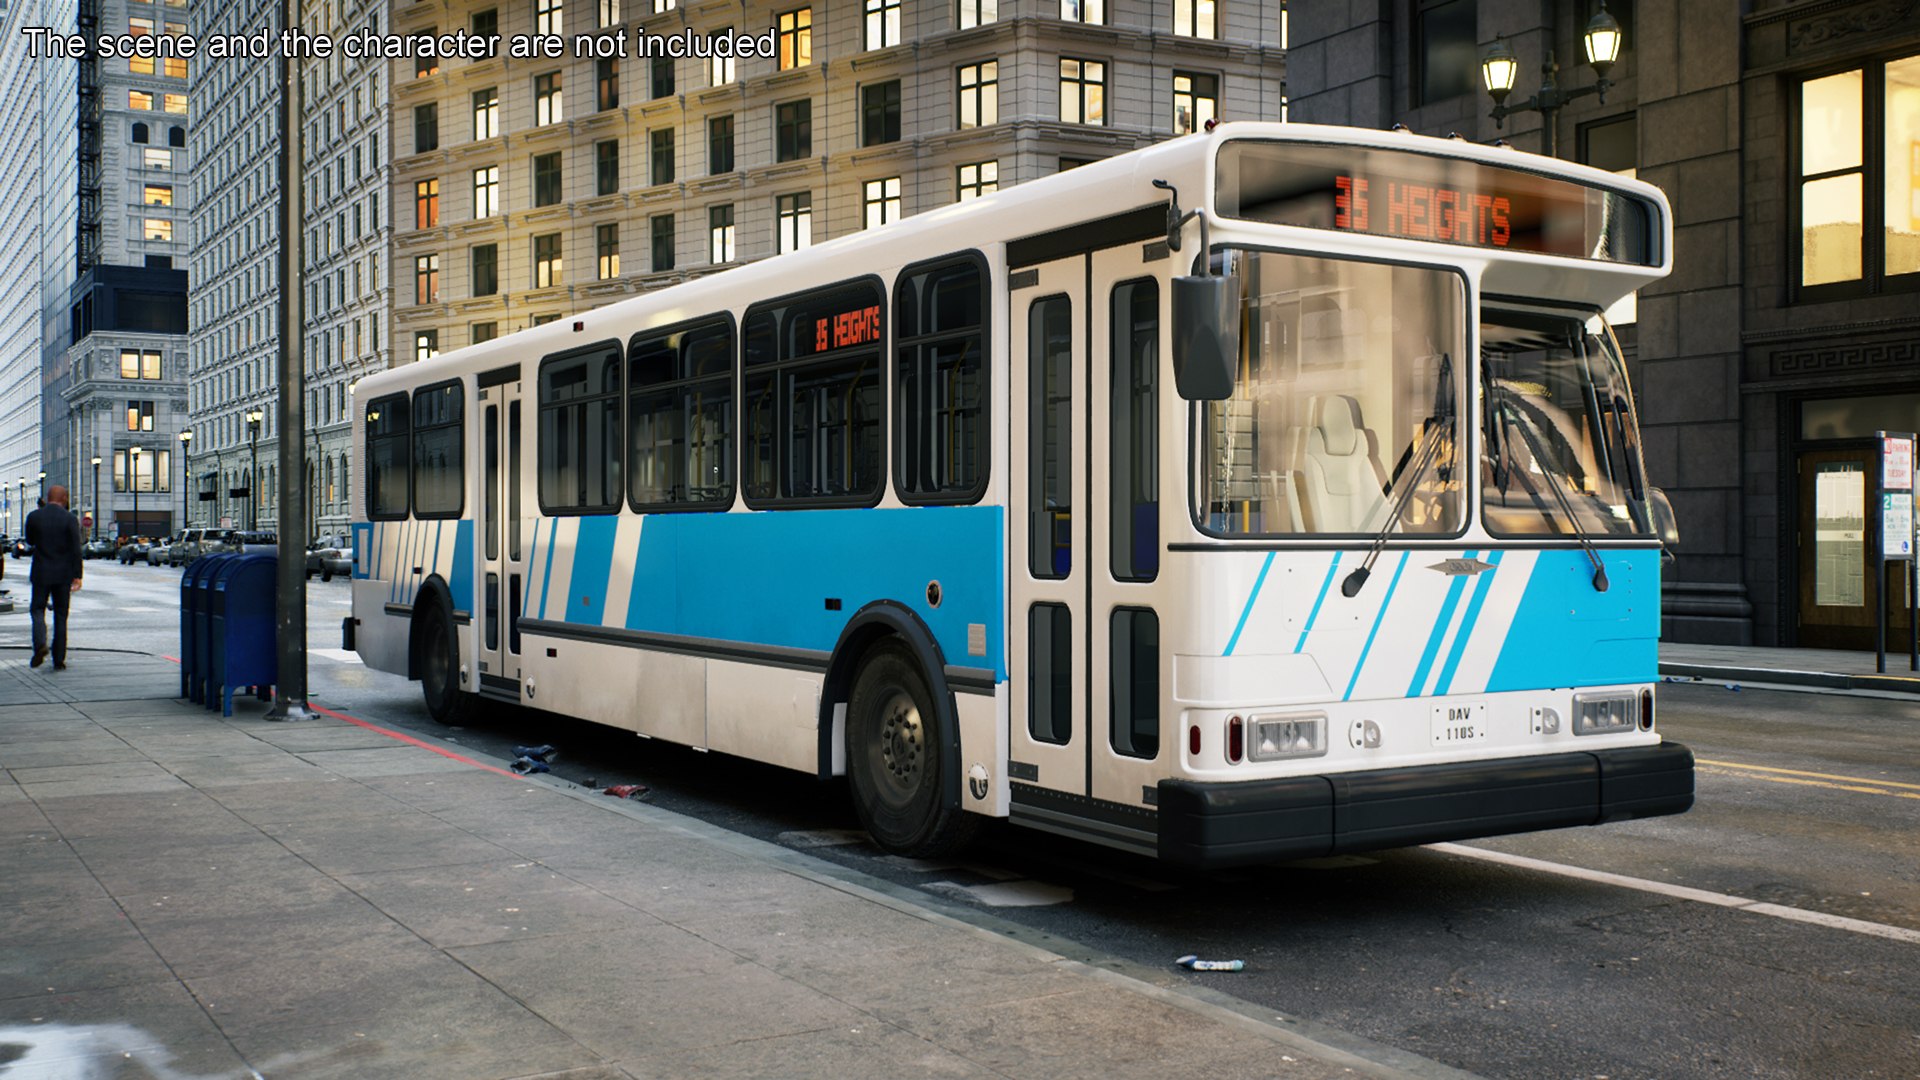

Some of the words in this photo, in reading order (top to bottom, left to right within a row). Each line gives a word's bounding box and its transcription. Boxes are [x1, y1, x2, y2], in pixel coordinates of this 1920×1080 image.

[1335, 175, 1368, 230] 35
[1388, 182, 1510, 246] HEIGHTS
[815, 318, 828, 352] 35
[833, 305, 879, 348] HEIGHTS
[1884, 495, 1890, 509] 2
[1448, 707, 1471, 721] DAV
